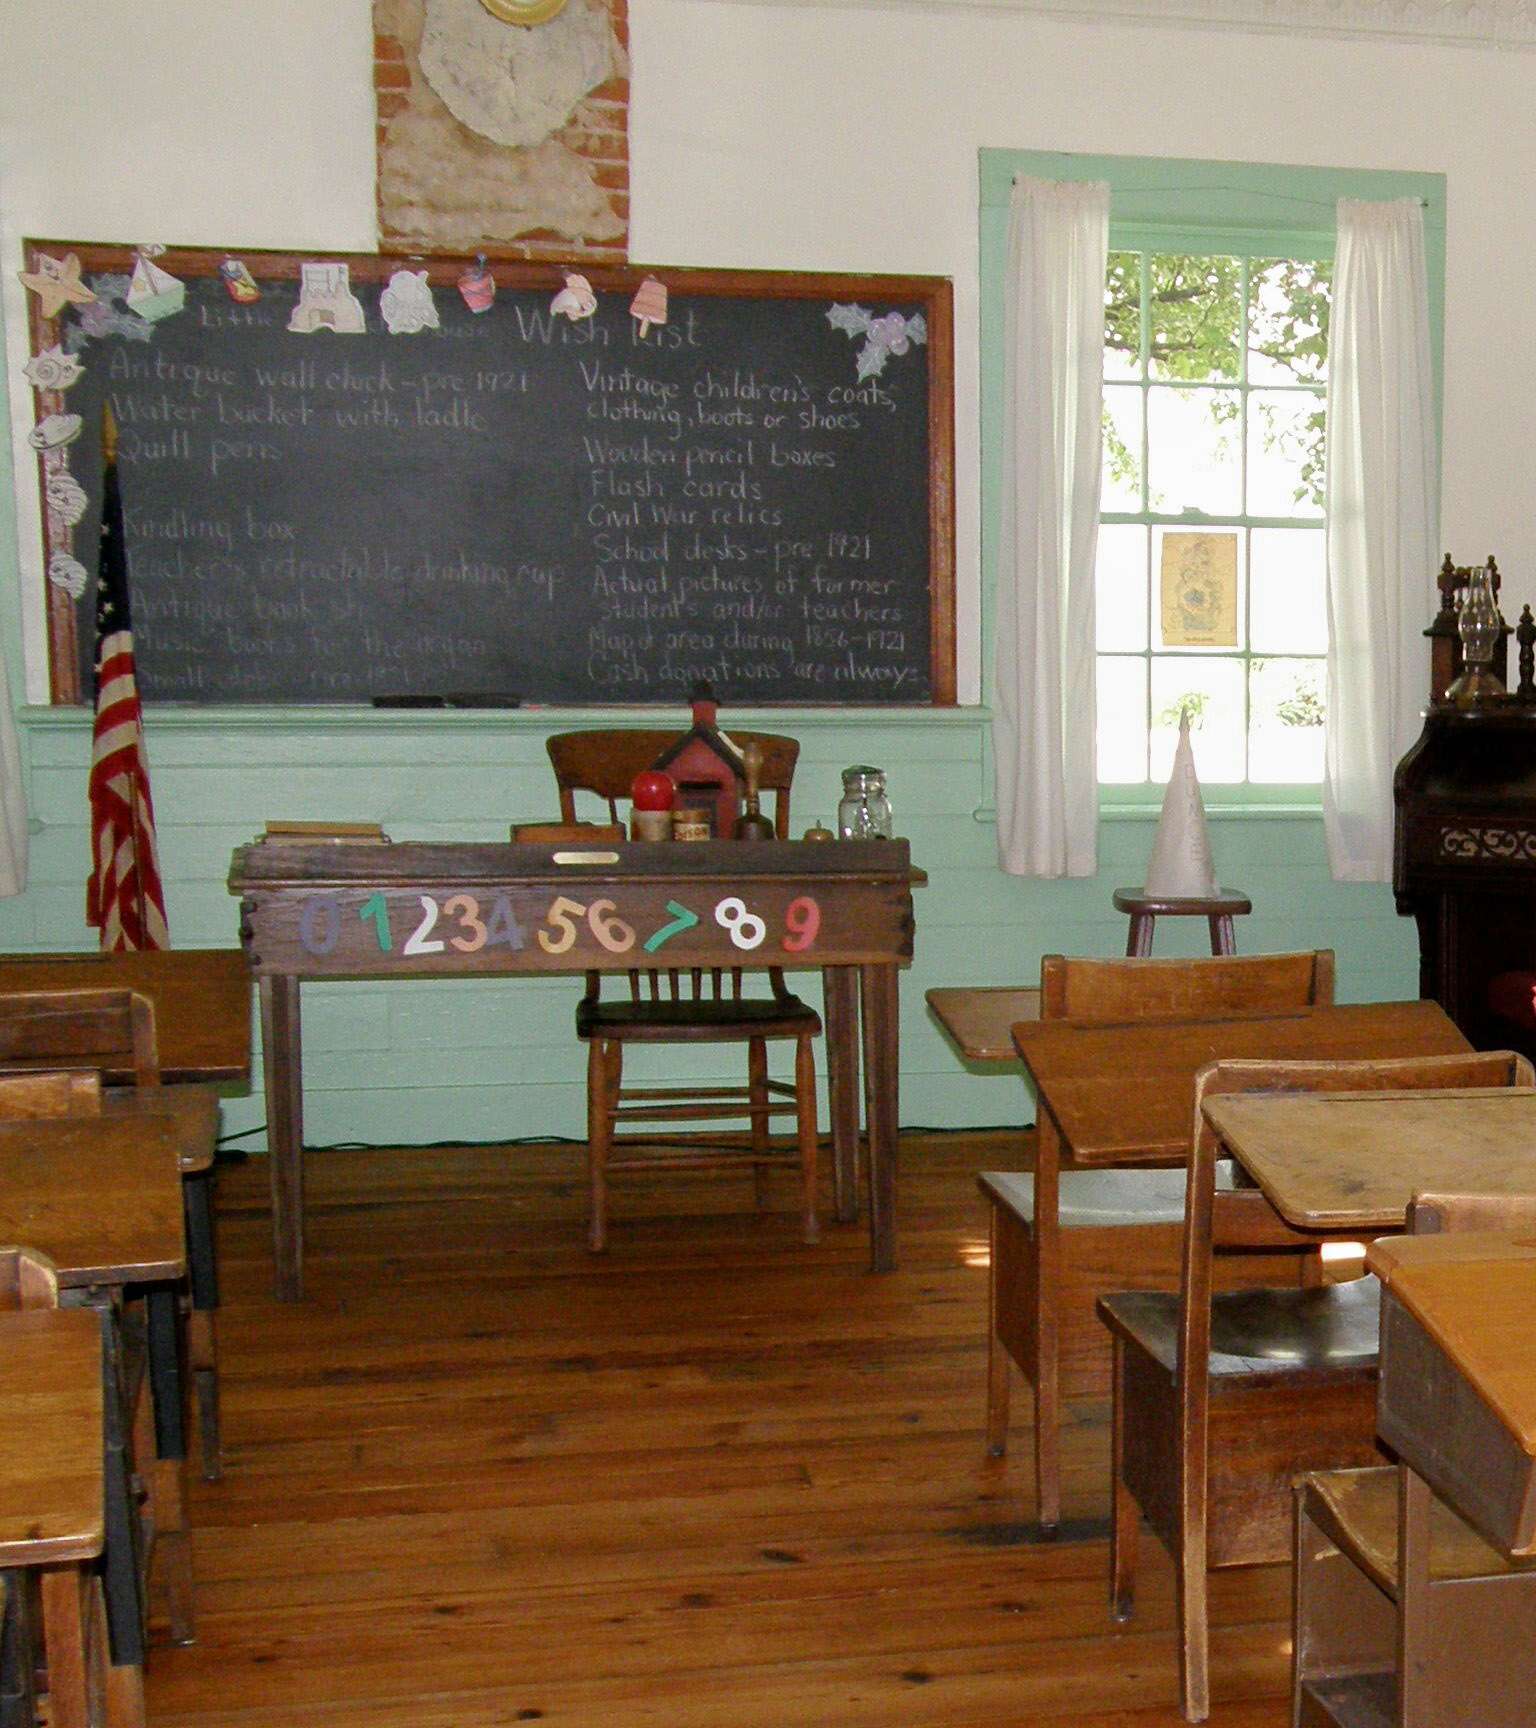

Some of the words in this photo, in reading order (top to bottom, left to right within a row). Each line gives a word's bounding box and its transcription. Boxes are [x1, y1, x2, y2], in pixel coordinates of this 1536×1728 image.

[513, 305, 610, 347] Wish
[630, 309, 703, 350] List
[109, 347, 238, 398] Antique
[255, 359, 316, 389] wall
[325, 360, 397, 392] clock
[475, 371, 529, 393] 1921
[578, 359, 680, 411] Vintage
[693, 370, 811, 403] children's
[111, 392, 201, 423] Water
[216, 392, 315, 426] bucket
[335, 398, 400, 428] with
[415, 395, 489, 432] ladle
[696, 401, 755, 426] boots
[762, 413, 789, 429] or
[798, 402, 862, 431] shoes
[115, 427, 190, 465] Quill
[211, 439, 283, 477] pens
[582, 435, 677, 465] Wooden
[684, 436, 755, 479] pencil
[769, 442, 837, 468] boxes
[590, 468, 665, 498] Flash
[681, 469, 763, 501] cards
[123, 505, 234, 552] Kindling
[245, 504, 296, 540] box
[586, 500, 641, 528] Civil
[651, 502, 699, 526] War
[710, 501, 783, 527] relics
[592, 530, 670, 564] School
[683, 531, 749, 562] desks
[773, 539, 814, 573] pre
[826, 530, 872, 561] 1921
[516, 563, 567, 602] cup
[591, 563, 668, 598] Actual
[678, 564, 764, 605] pictures
[774, 564, 799, 596] of
[810, 563, 898, 596] former
[799, 594, 903, 623] teachers
[588, 623, 635, 660] Map
[664, 631, 716, 651] area
[722, 620, 796, 668] during
[586, 649, 650, 686] Cash
[793, 661, 826, 684] are
